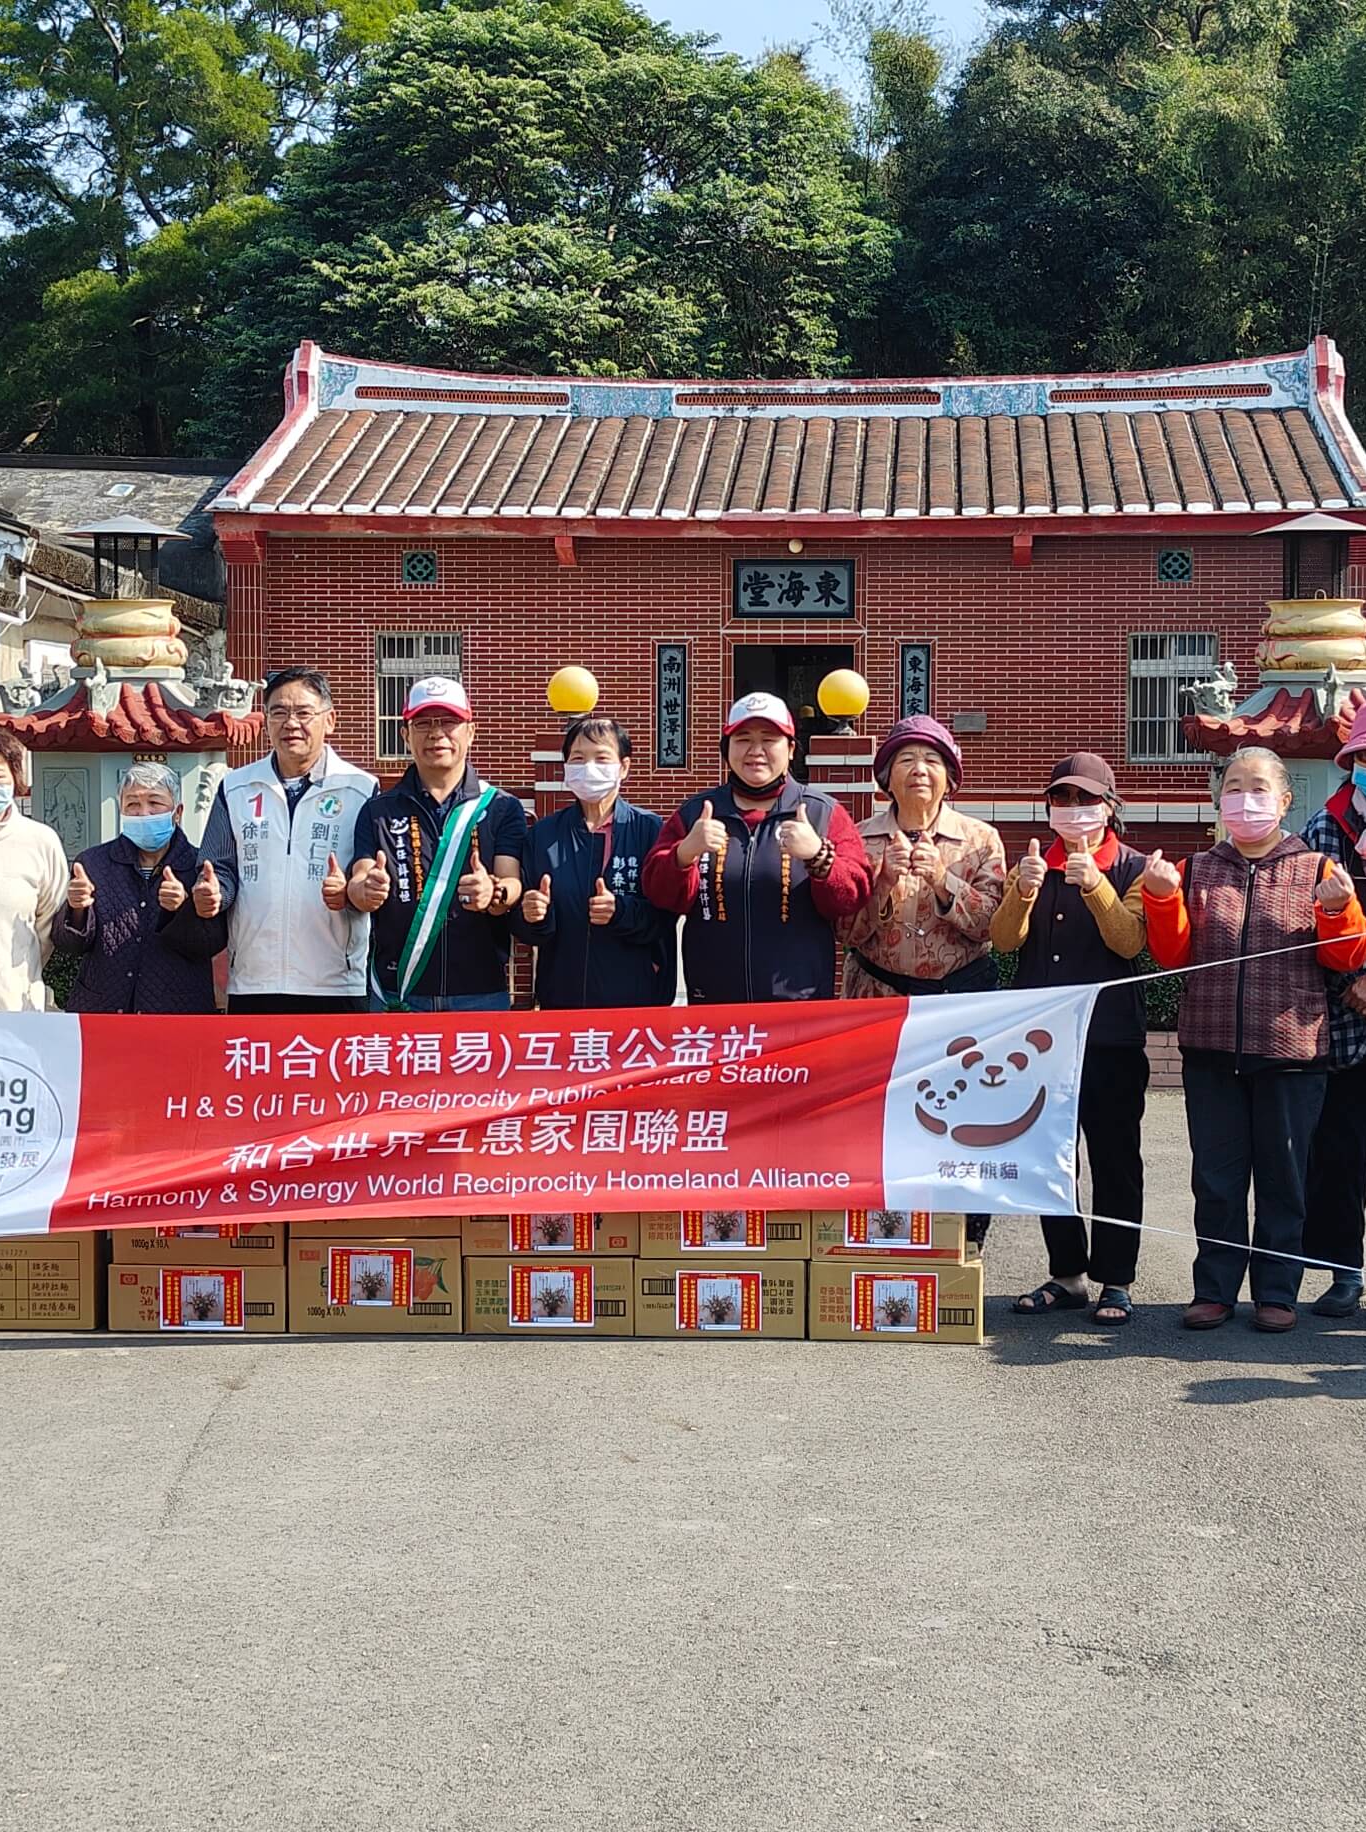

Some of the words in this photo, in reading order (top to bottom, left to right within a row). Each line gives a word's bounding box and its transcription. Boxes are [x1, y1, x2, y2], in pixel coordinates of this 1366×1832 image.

[224, 1024, 768, 1082] 和合(積福易)互惠公益站
[166, 1096, 187, 1119] H
[196, 1096, 215, 1118] &
[225, 1095, 244, 1117] S
[253, 1094, 283, 1122] (Ji
[292, 1093, 326, 1116] Fu
[336, 1091, 369, 1116] Yi)
[378, 1087, 521, 1114] Reciprocity
[719, 1062, 809, 1084] Station
[87, 1188, 211, 1210] Harmony
[220, 1183, 239, 1202] &
[248, 1178, 358, 1207] Synergy
[366, 1173, 443, 1198] World
[453, 1171, 597, 1197] Reciprocity
[607, 1168, 738, 1191] Homeland
[748, 1168, 850, 1189] Alliance
[938, 1160, 1018, 1180] 微笑熊貓
